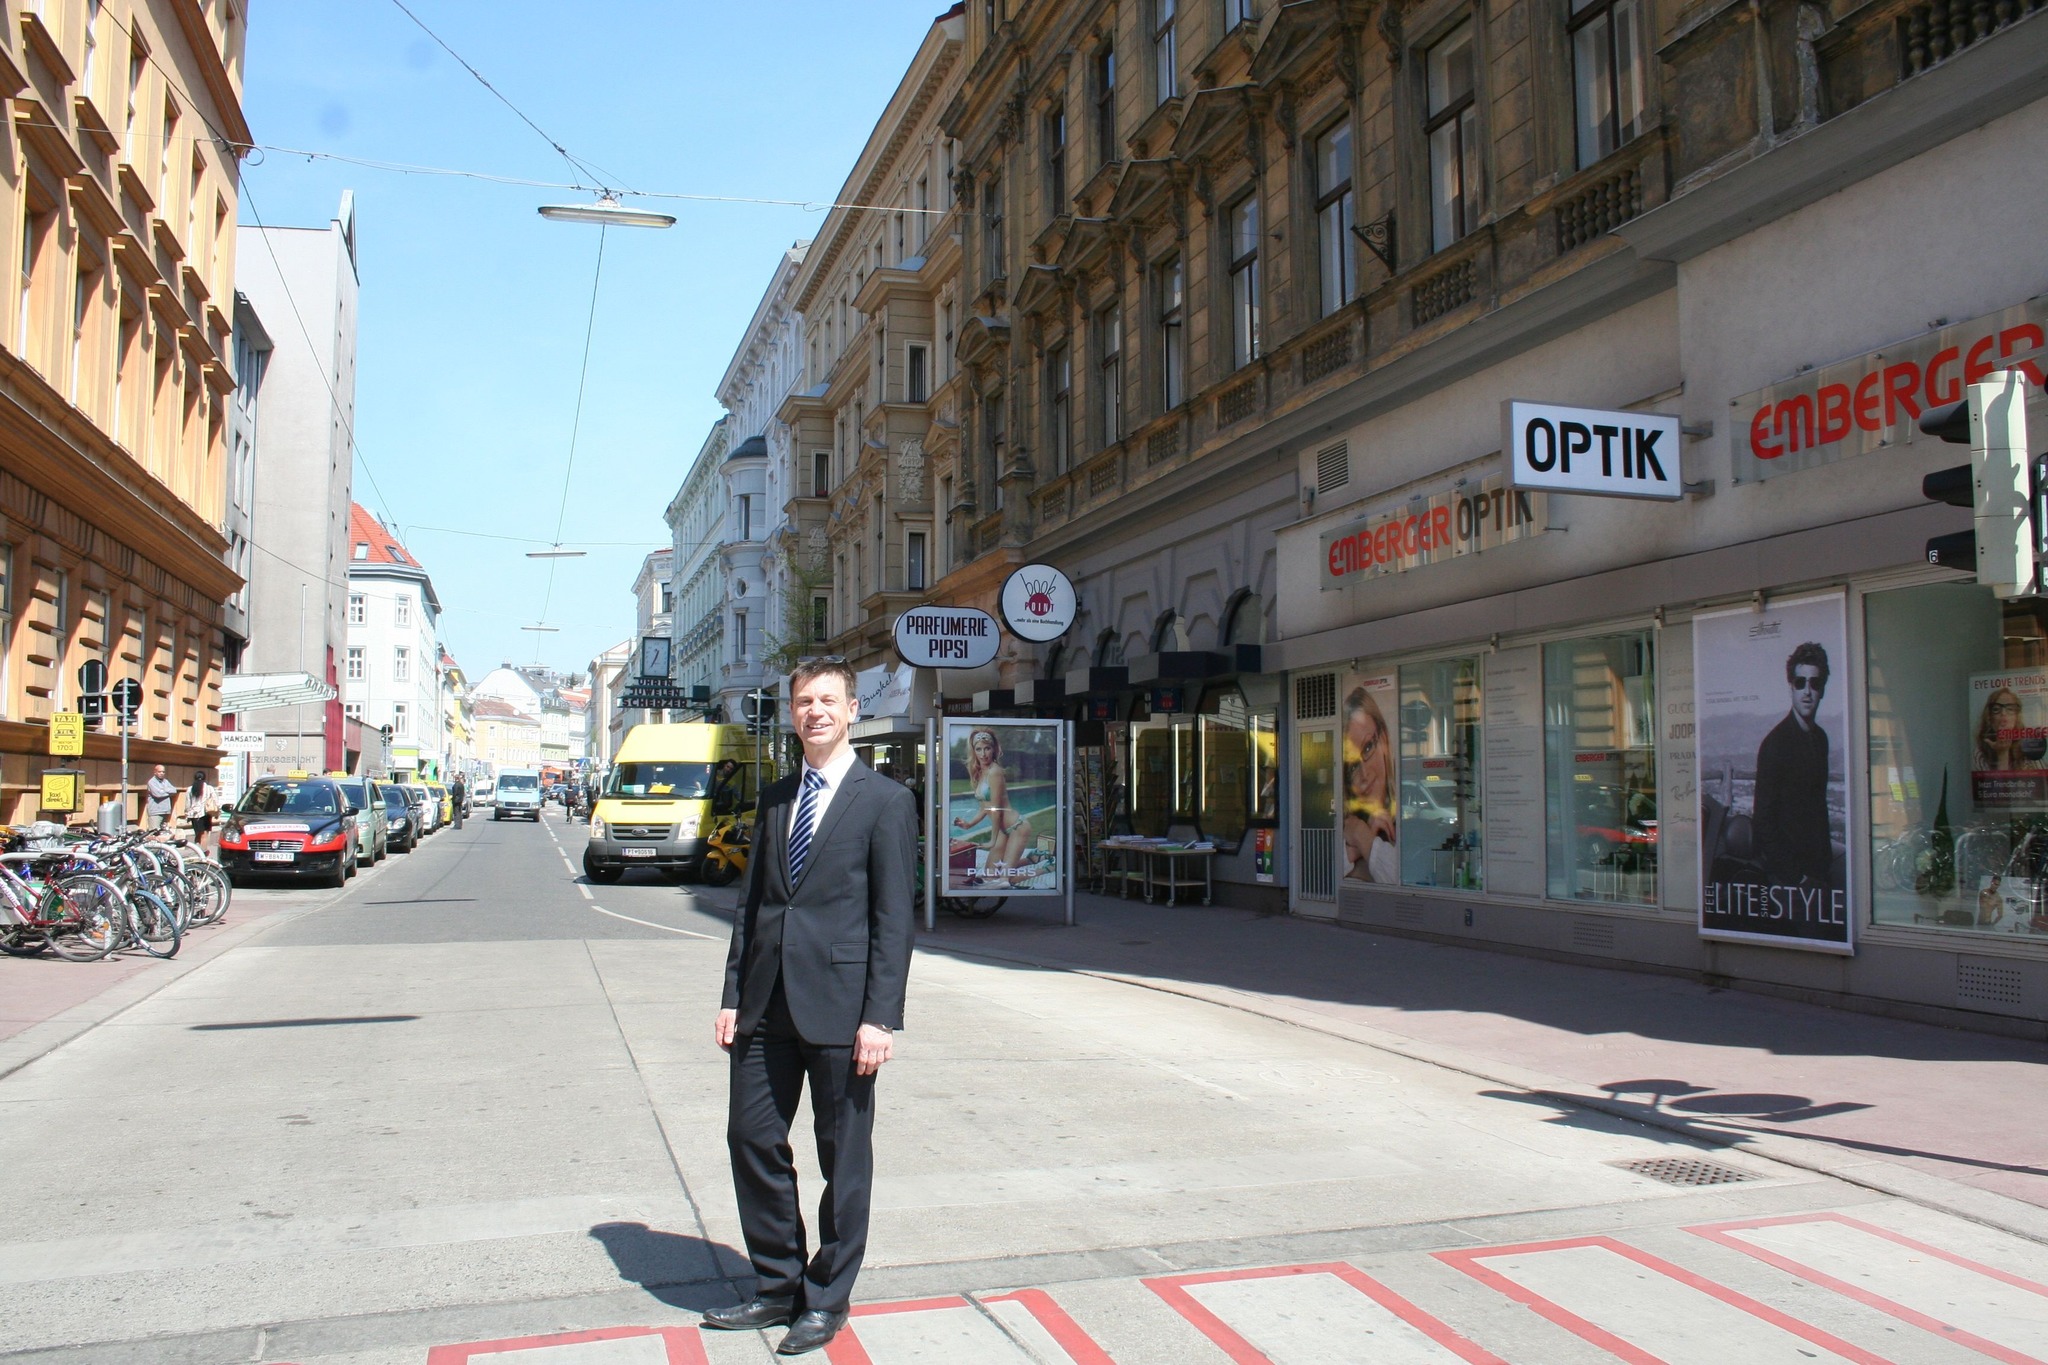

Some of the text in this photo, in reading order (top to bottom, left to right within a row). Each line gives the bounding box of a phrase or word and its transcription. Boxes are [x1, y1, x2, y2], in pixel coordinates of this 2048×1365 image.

[1525, 417, 1668, 481] OPTIK
[1328, 489, 1534, 577] EMBERGER OPTIK
[1020, 573, 1057, 600] book
[1024, 602, 1054, 613] POINT
[906, 615, 988, 637] PARFUMERIE
[929, 639, 968, 659] PIPSI
[1974, 675, 2046, 690] EYE LOVE TRENDS
[630, 688, 680, 696] JUWELEN
[622, 698, 688, 707] SCHERZER
[1667, 703, 1694, 715] GUCC
[967, 867, 1037, 877] PALMERS
[1705, 882, 1714, 914] FEEL
[1715, 882, 1758, 917] LITE
[1769, 885, 1844, 925] STYLE
